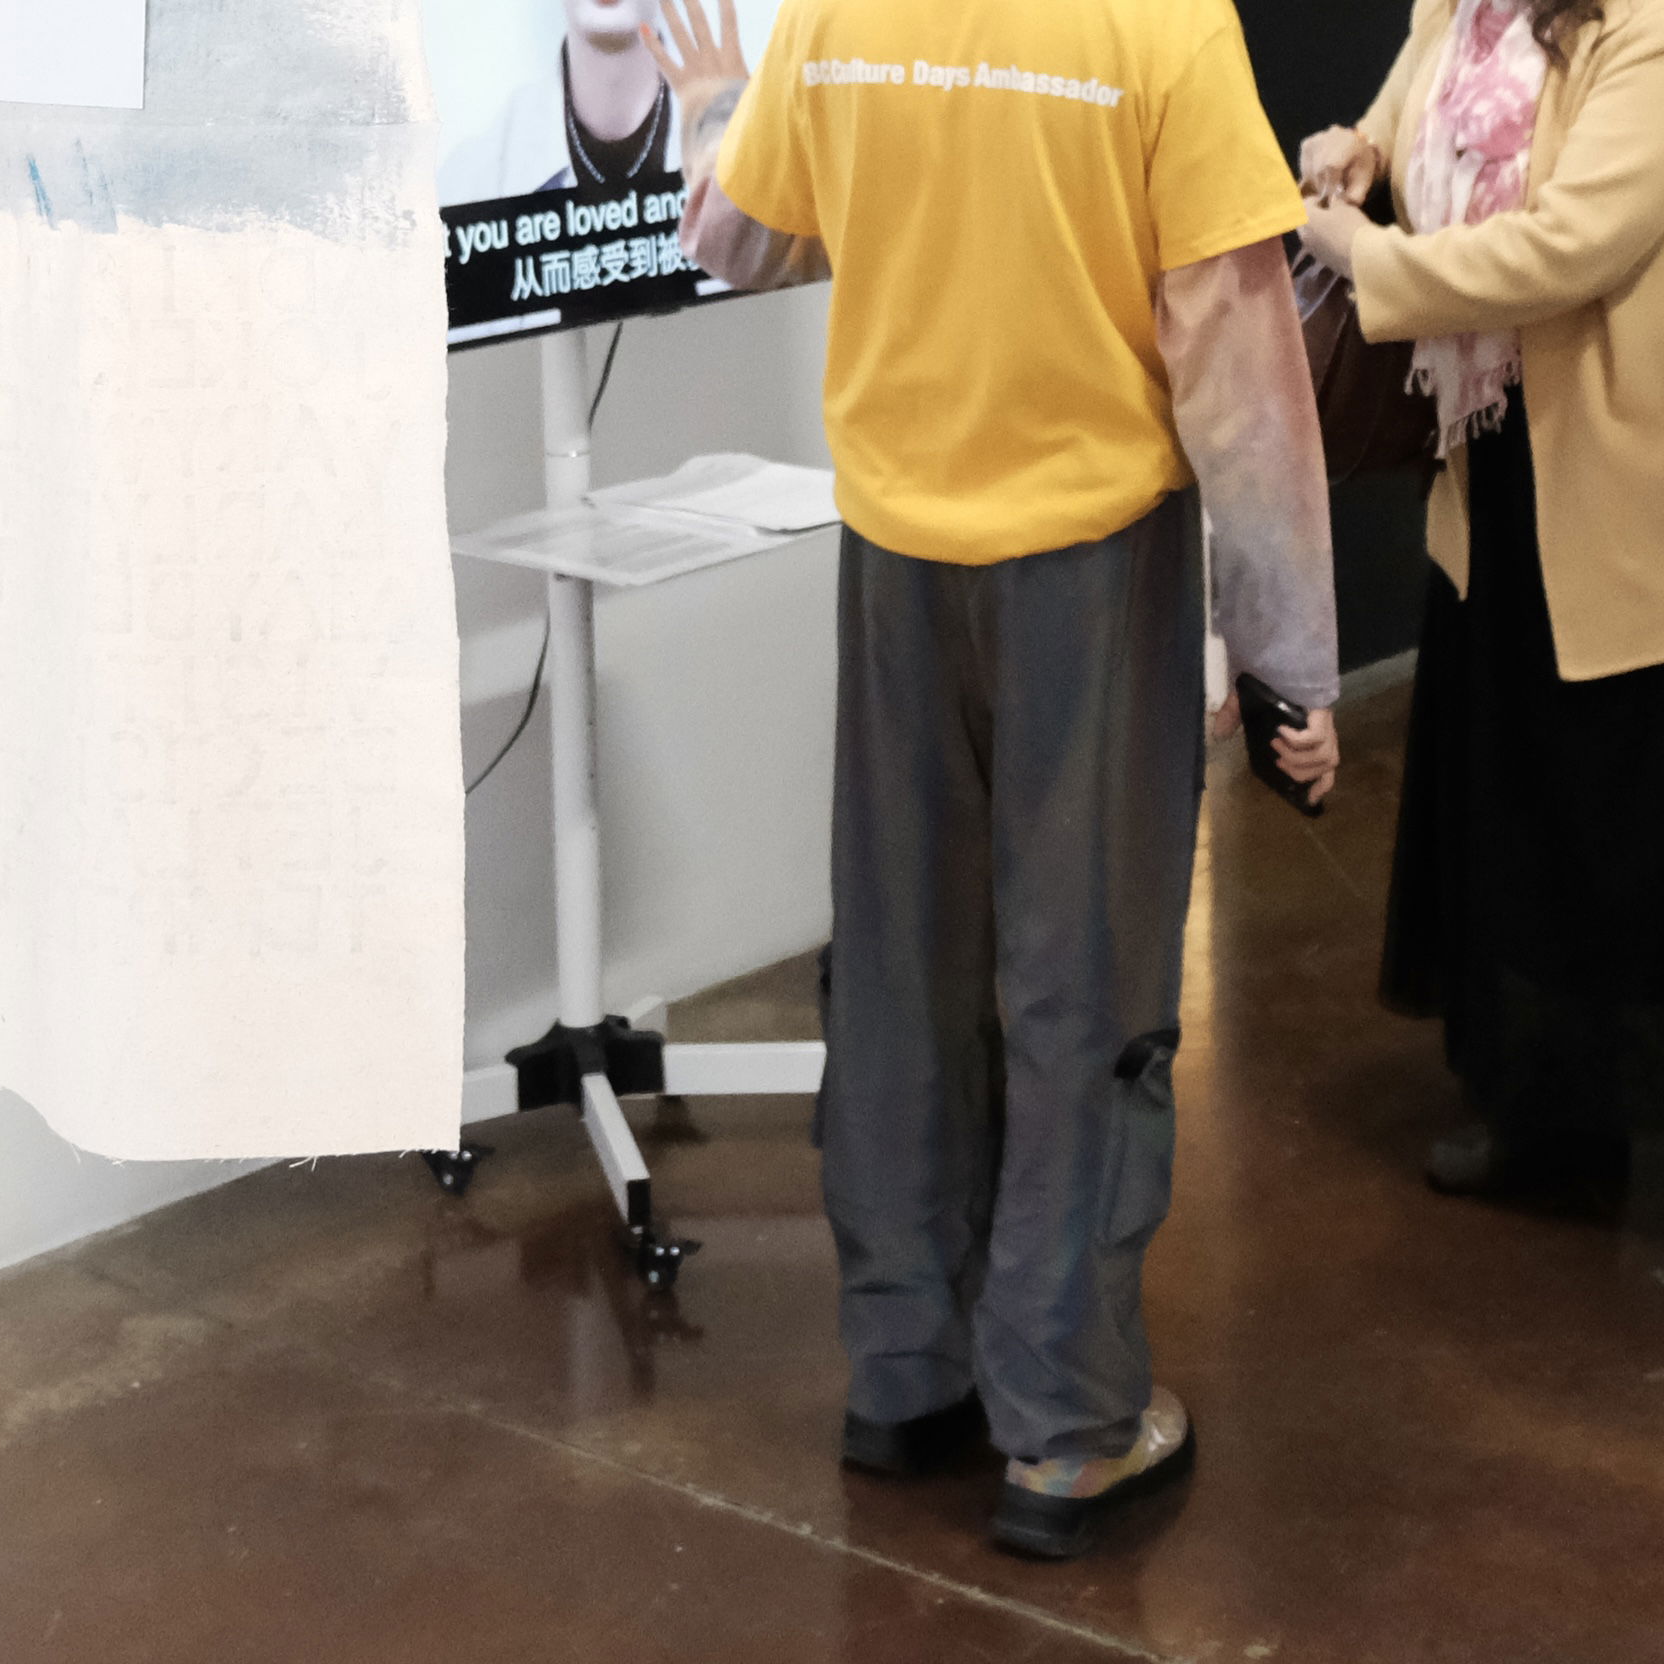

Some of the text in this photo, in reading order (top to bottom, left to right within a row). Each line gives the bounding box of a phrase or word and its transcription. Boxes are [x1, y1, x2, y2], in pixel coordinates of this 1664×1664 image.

[913, 59, 971, 92] Days
[974, 59, 1125, 108] Ambassador
[456, 219, 510, 265] you
[515, 210, 561, 247] are
[565, 189, 638, 237] loved
[510, 232, 702, 302] 从而感受到被
